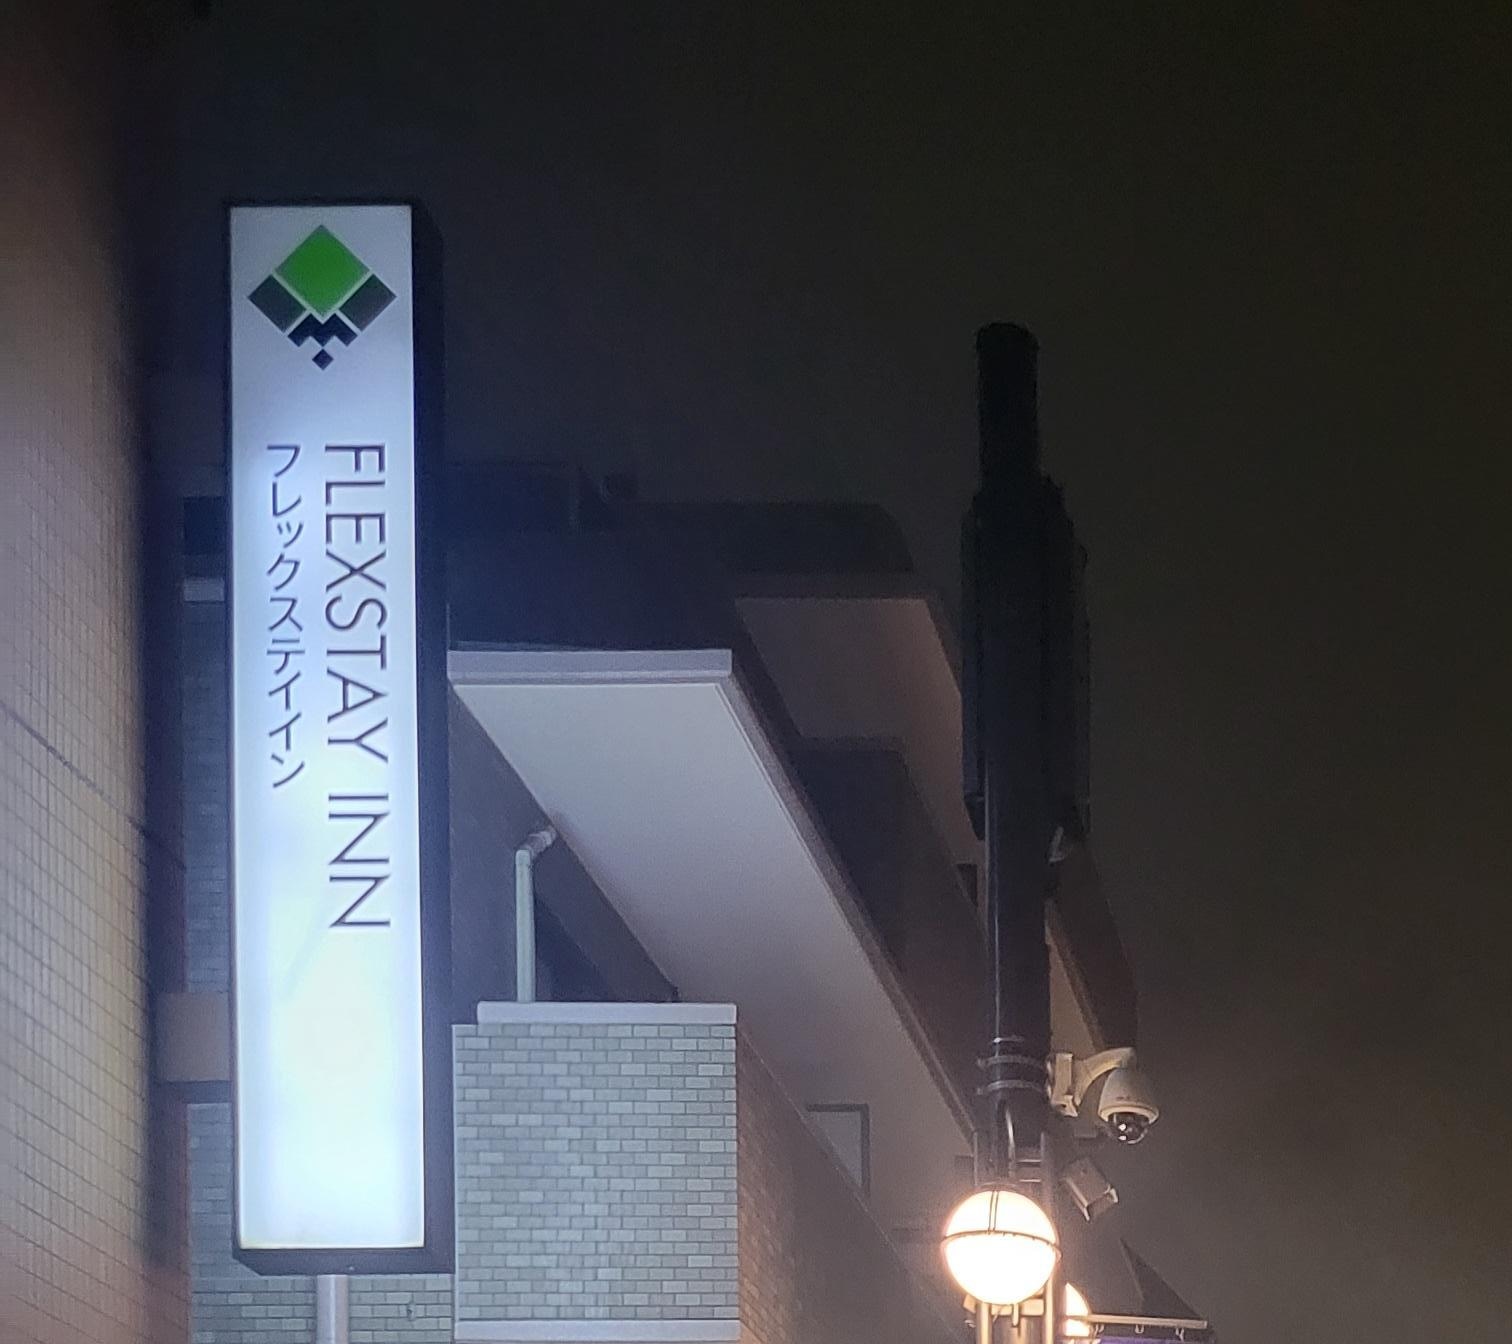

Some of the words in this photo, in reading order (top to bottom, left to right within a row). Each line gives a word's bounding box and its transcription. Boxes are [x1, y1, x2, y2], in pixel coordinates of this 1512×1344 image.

[266, 444, 306, 789] フレックステイイン
[324, 442, 388, 764] FLEXSTAY
[327, 792, 391, 929] INN
